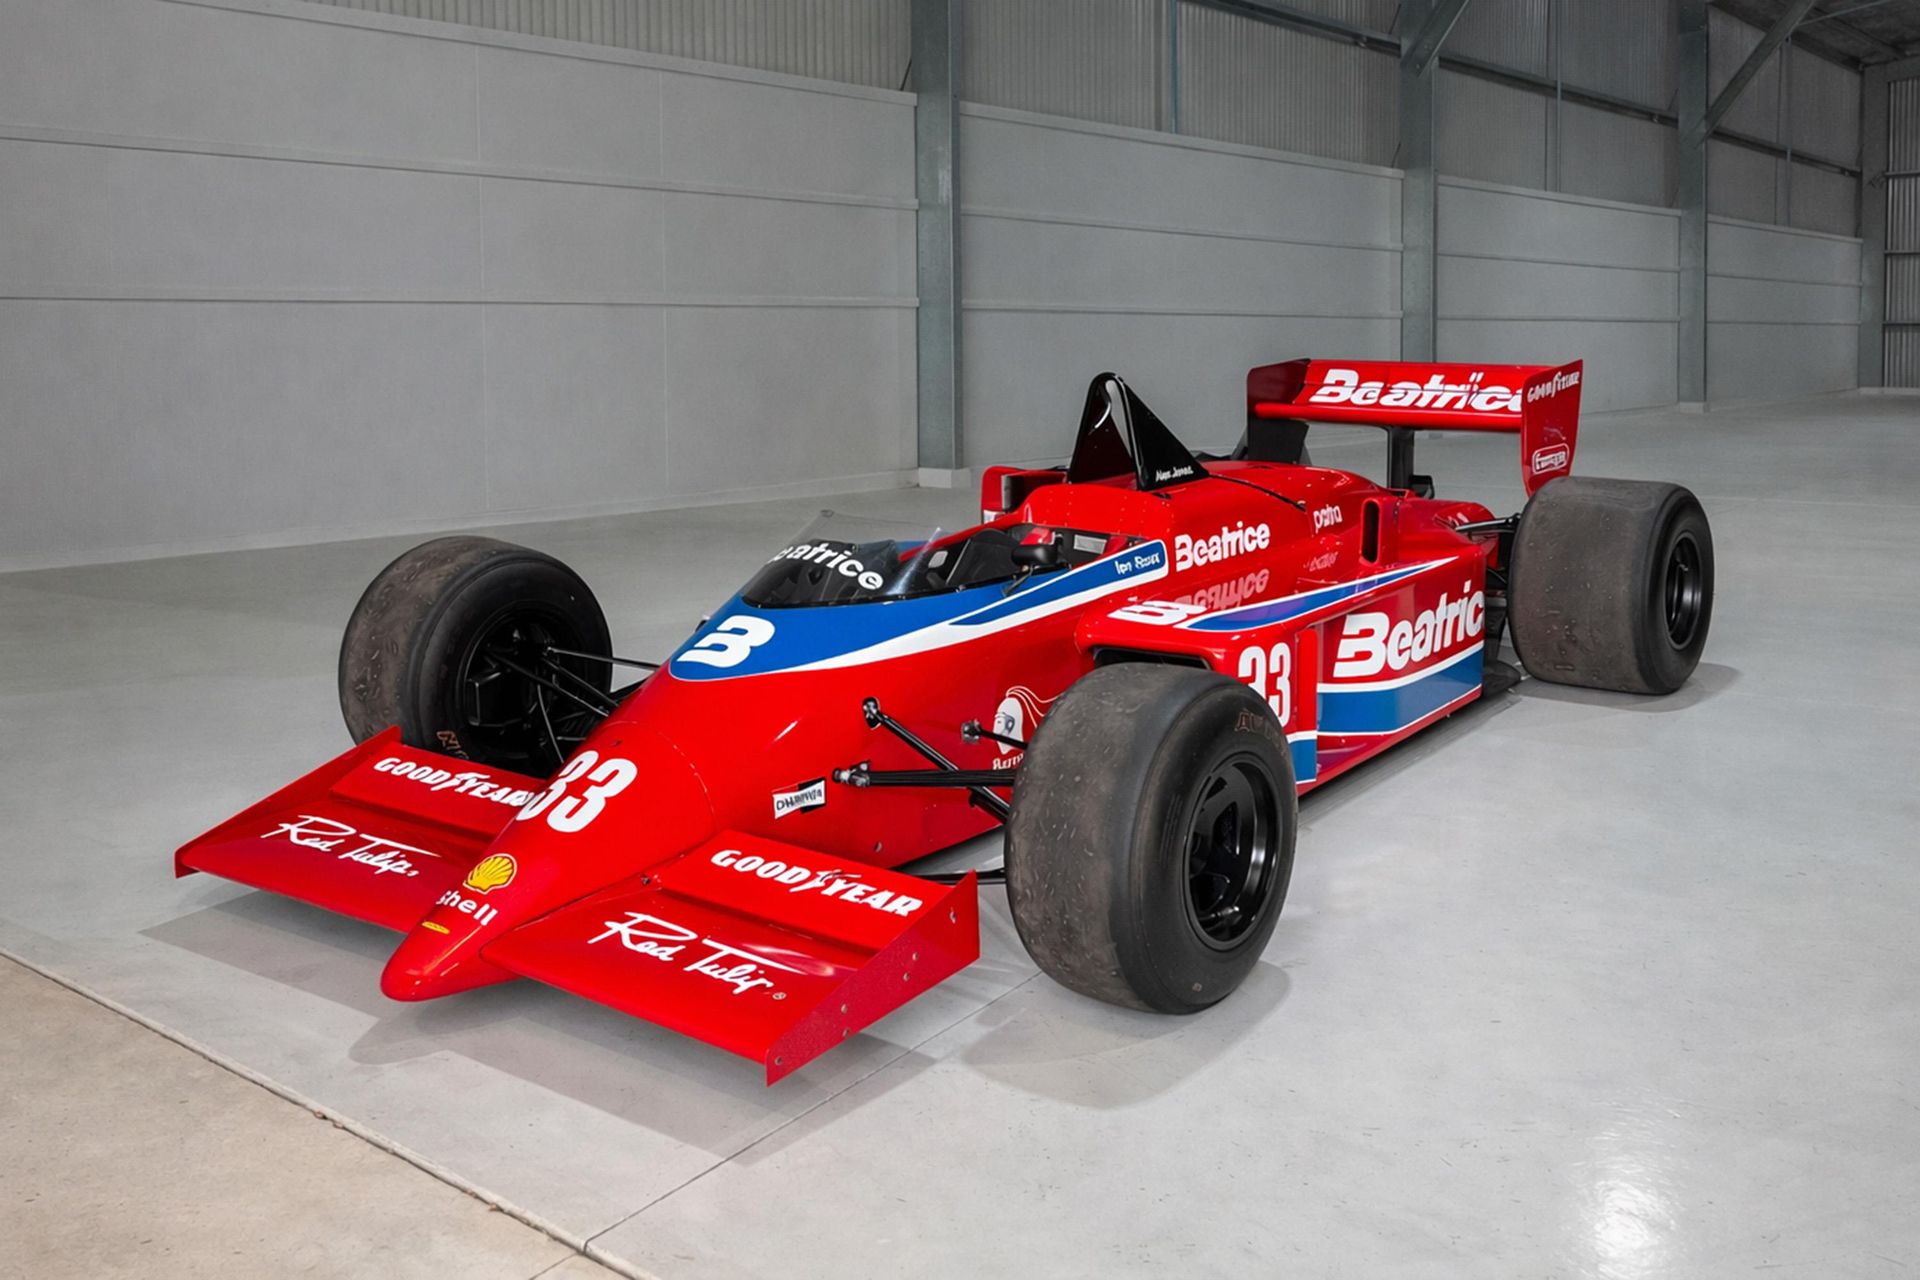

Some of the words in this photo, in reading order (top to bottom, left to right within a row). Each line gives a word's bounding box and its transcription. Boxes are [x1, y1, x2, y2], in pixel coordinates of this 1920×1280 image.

[767, 542, 884, 590] eatrice
[1174, 521, 1271, 572] Beatrice
[1333, 580, 1485, 678] Beatric
[516, 750, 638, 833] 33
[260, 814, 357, 852] Red
[711, 849, 923, 917] GOODYEAR
[587, 911, 699, 962] Red
